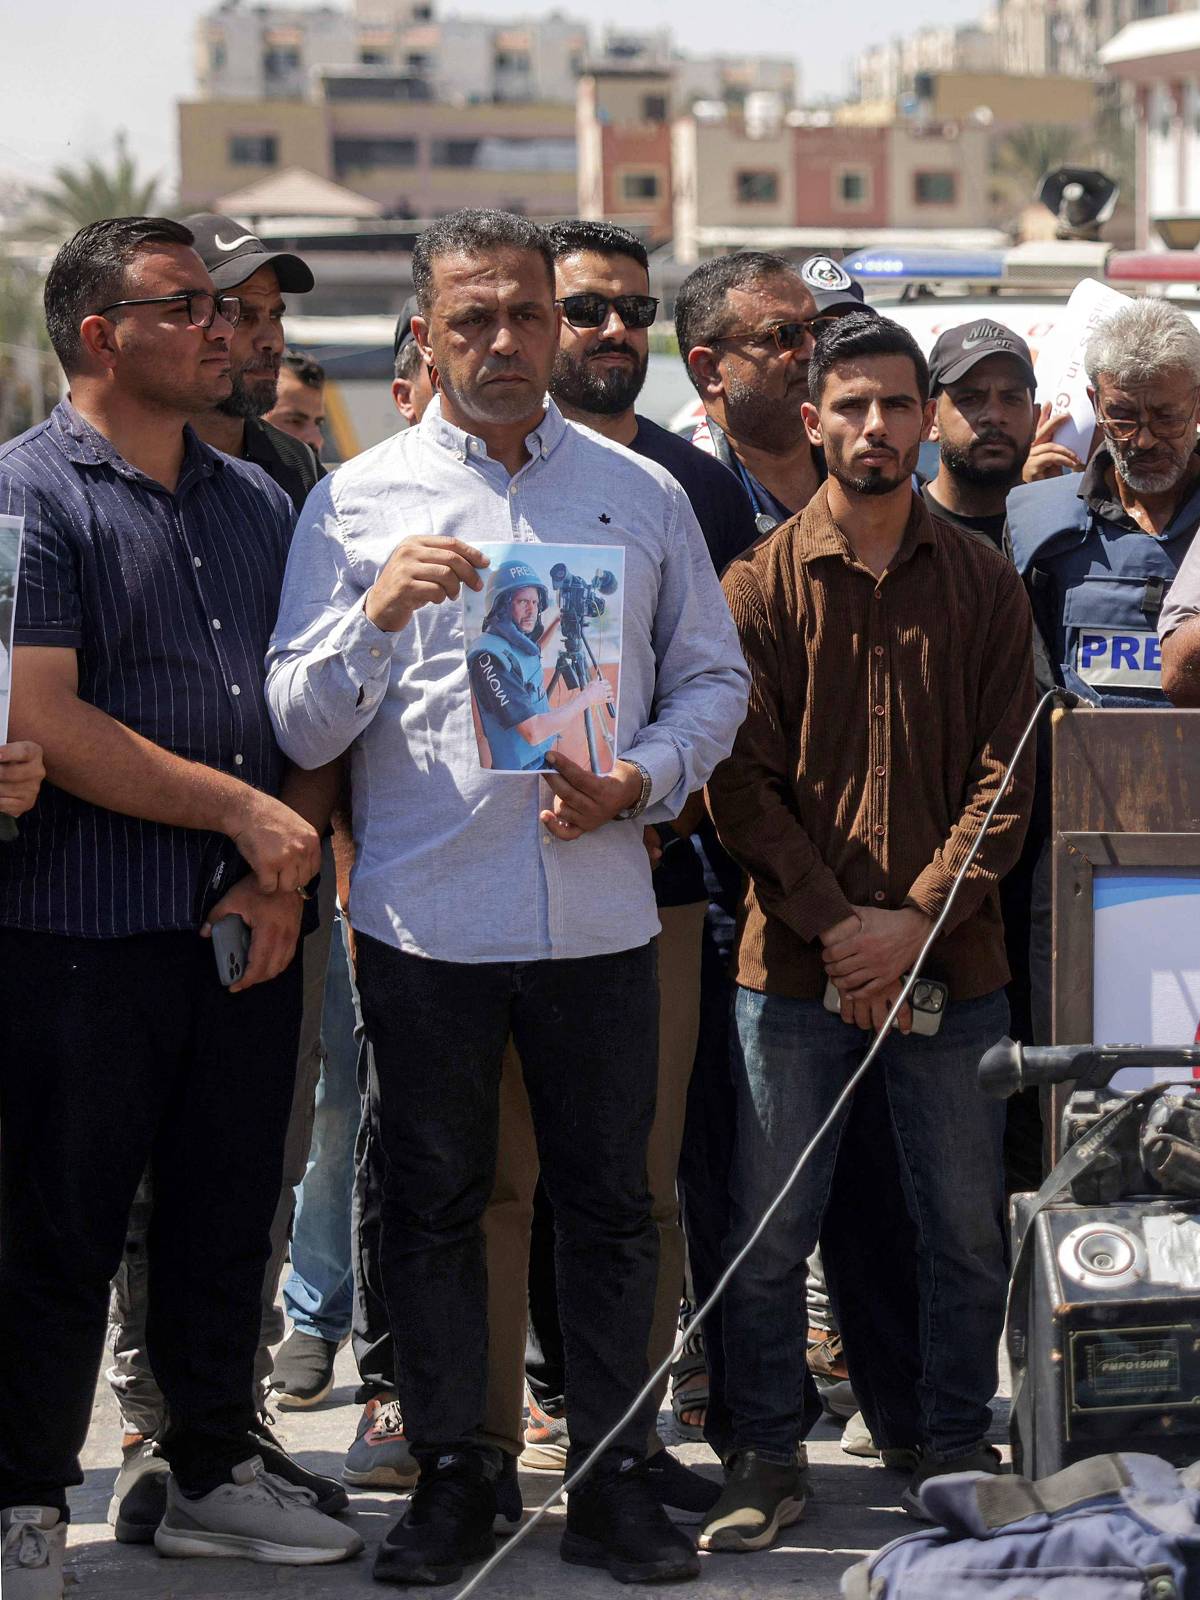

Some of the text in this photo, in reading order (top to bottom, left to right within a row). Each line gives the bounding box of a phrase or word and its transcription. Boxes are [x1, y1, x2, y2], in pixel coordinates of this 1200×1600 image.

[969, 325, 1005, 338] NIKE
[1081, 635, 1162, 671] PRE
[1102, 1359, 1170, 1371] PMPO1500W
